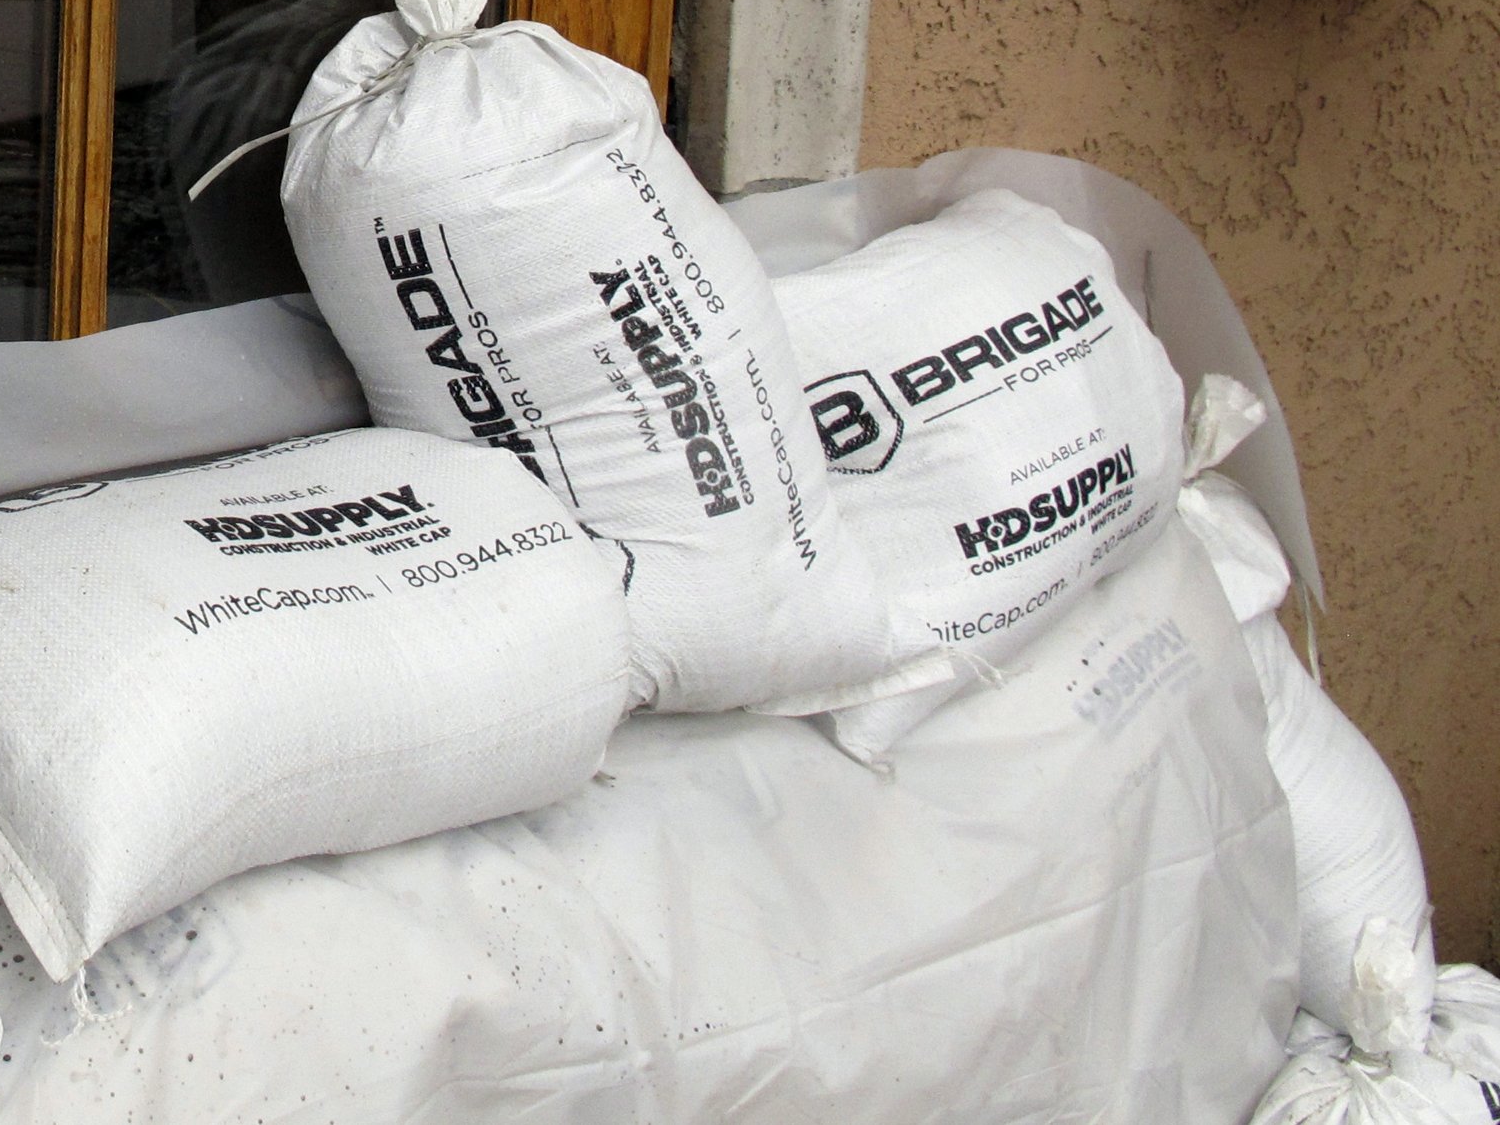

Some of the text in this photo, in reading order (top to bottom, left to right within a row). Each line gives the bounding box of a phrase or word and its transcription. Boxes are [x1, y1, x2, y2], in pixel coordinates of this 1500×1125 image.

[634, 259, 694, 354] INDUSTRIAL
[647, 253, 702, 342] WHITE CAP
[468, 310, 521, 385] PROS
[889, 276, 1105, 407] BRIGADE
[1003, 338, 1092, 392] FOR PROS
[256, 436, 330, 460] PROS
[695, 368, 754, 505] CONSTRUCTION
[1009, 435, 1085, 486] AVAILABLE
[219, 489, 306, 509] AVAILABLE
[970, 521, 1078, 577] CONSTRUCTION
[1087, 484, 1135, 521] INDUSTRIAL
[1090, 507, 1117, 535] WHITE
[219, 514, 442, 557] CONSTRUCTION & INDUSTRIAL
[365, 526, 453, 557] WHITE CAP
[174, 521, 573, 636] WhiteCap.com 800.944.8322
[927, 577, 1066, 643] hiteCap.com
